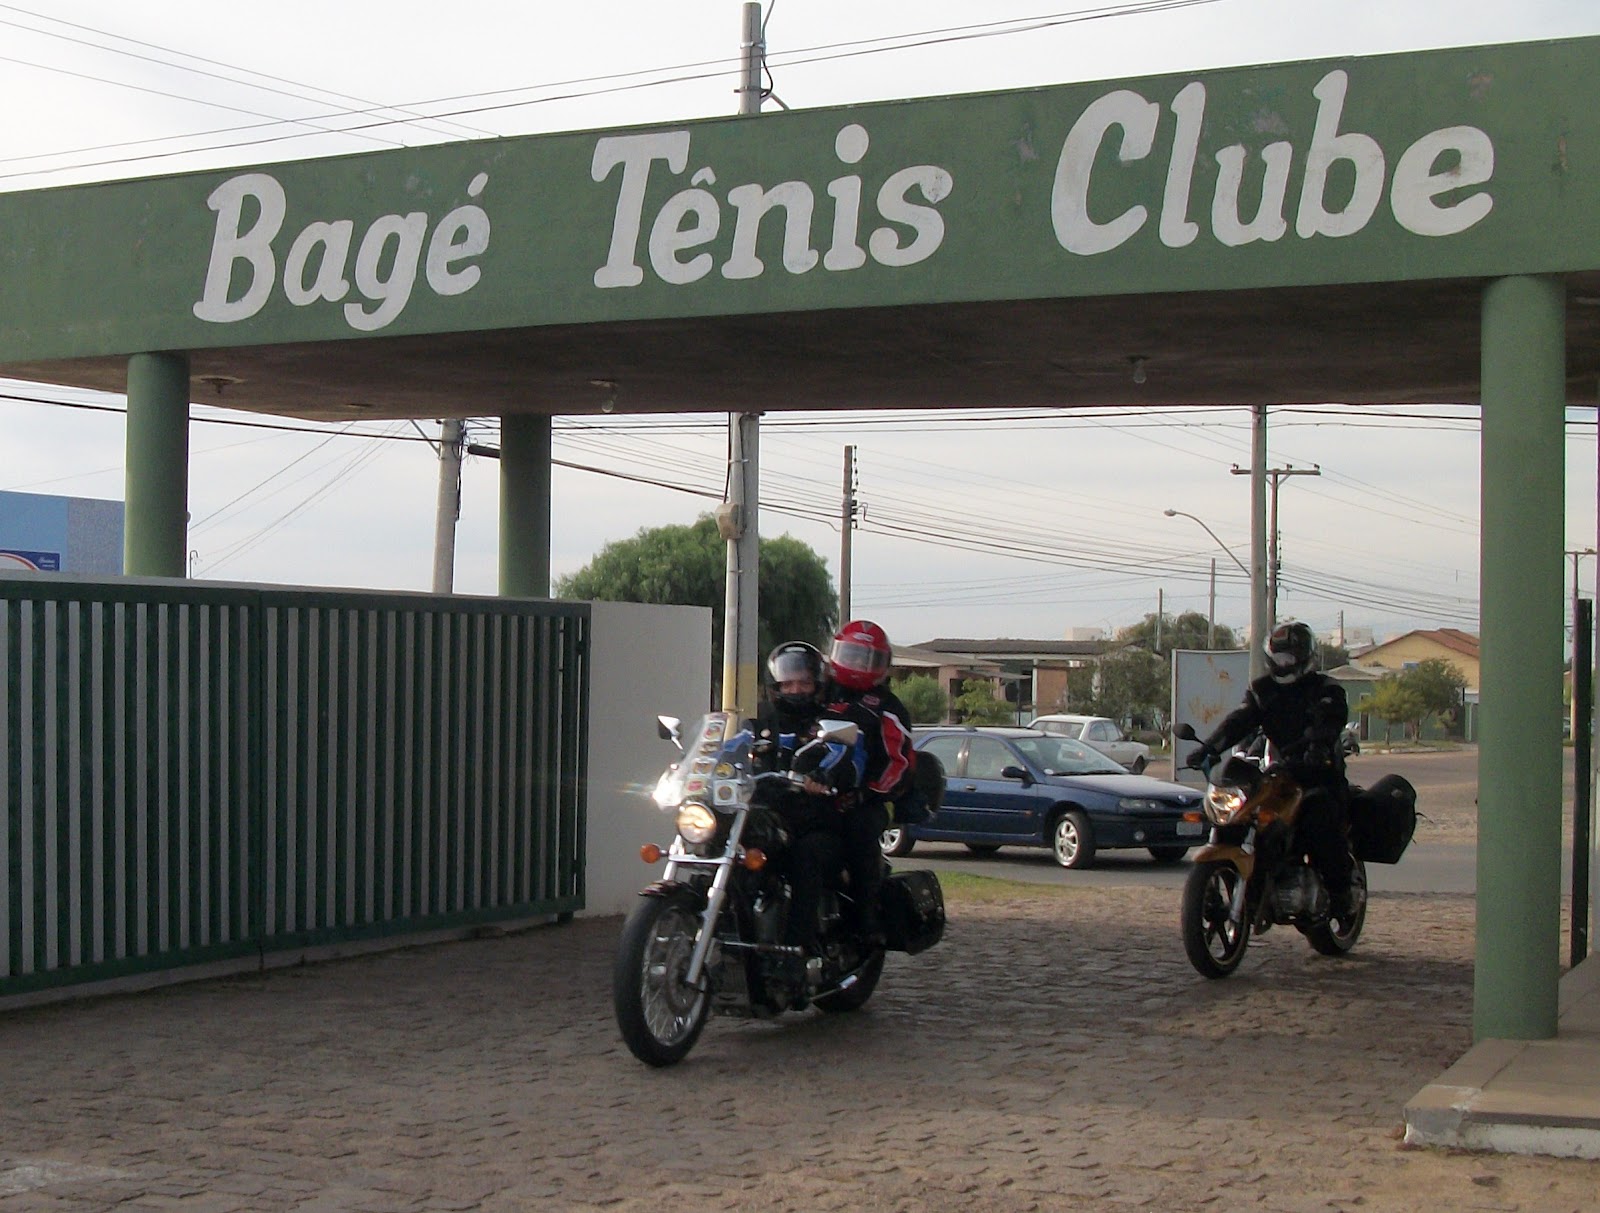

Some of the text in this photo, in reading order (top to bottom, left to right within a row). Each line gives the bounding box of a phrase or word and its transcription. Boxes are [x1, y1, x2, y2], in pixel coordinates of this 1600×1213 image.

[192, 69, 1496, 333] Bagé Tênis Clube
